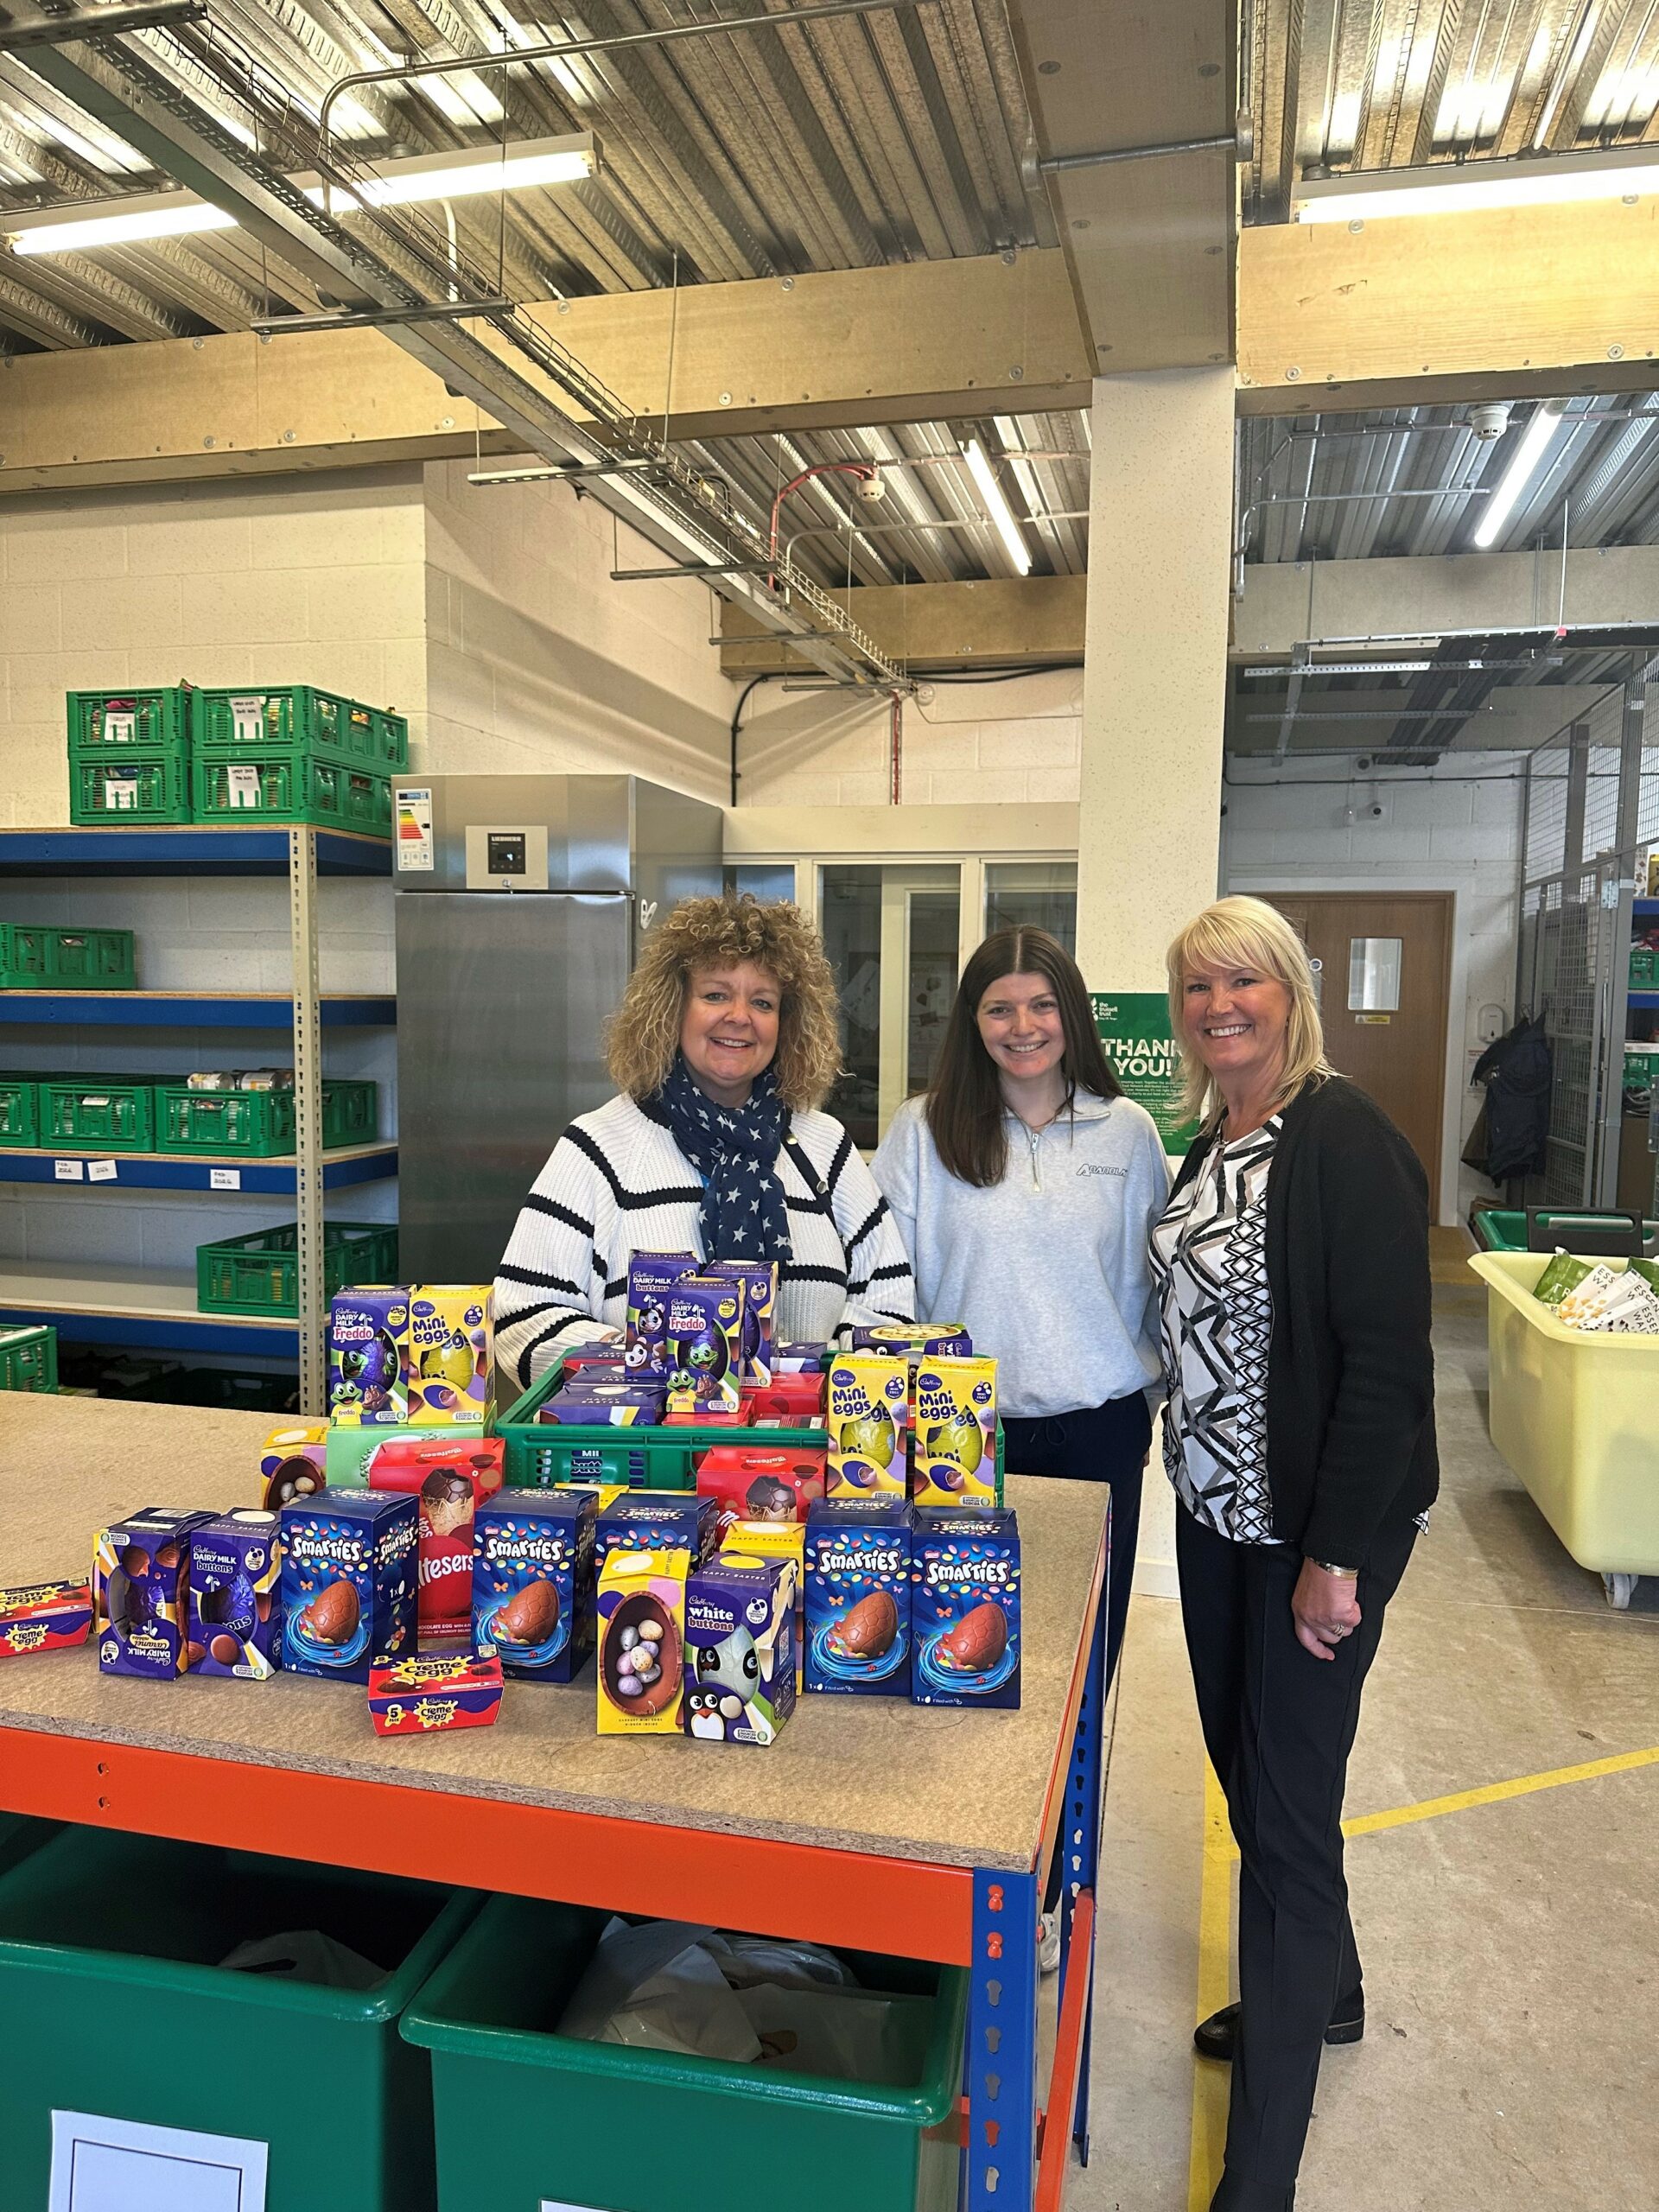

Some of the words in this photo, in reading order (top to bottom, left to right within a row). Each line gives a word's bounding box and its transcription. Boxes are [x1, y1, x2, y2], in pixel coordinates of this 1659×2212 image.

[1113, 1058, 1172, 1077] YOU!
[412, 1315, 446, 1332] Mini
[670, 1319, 705, 1330] Freddo
[335, 1328, 373, 1340] Freddo
[413, 1329, 450, 1344] eggs
[832, 1386, 866, 1403] Mini
[919, 1391, 953, 1408] Mini
[833, 1400, 871, 1415] eggs
[920, 1405, 958, 1421] eggs
[745, 1456, 787, 1464] Maltesers
[193, 1545, 217, 1554] Cadbury
[193, 1553, 217, 1562] DAIRY
[217, 1555, 237, 1565] MILK
[197, 1561, 233, 1574] buttons
[5, 1596, 43, 1605] egg
[689, 1596, 715, 1608] Cadbury
[689, 1606, 734, 1621] white
[688, 1617, 734, 1631] buttons
[13, 1630, 43, 1641] creme
[18, 1636, 38, 1646] egg
[127, 1647, 147, 1656] MILK
[146, 1649, 171, 1658] DAIRY
[404, 1662, 464, 1673] creme
[414, 1668, 453, 1678] egg
[390, 1707, 398, 1718] 5
[421, 1705, 453, 1717] creme
[426, 1713, 447, 1722] egg
